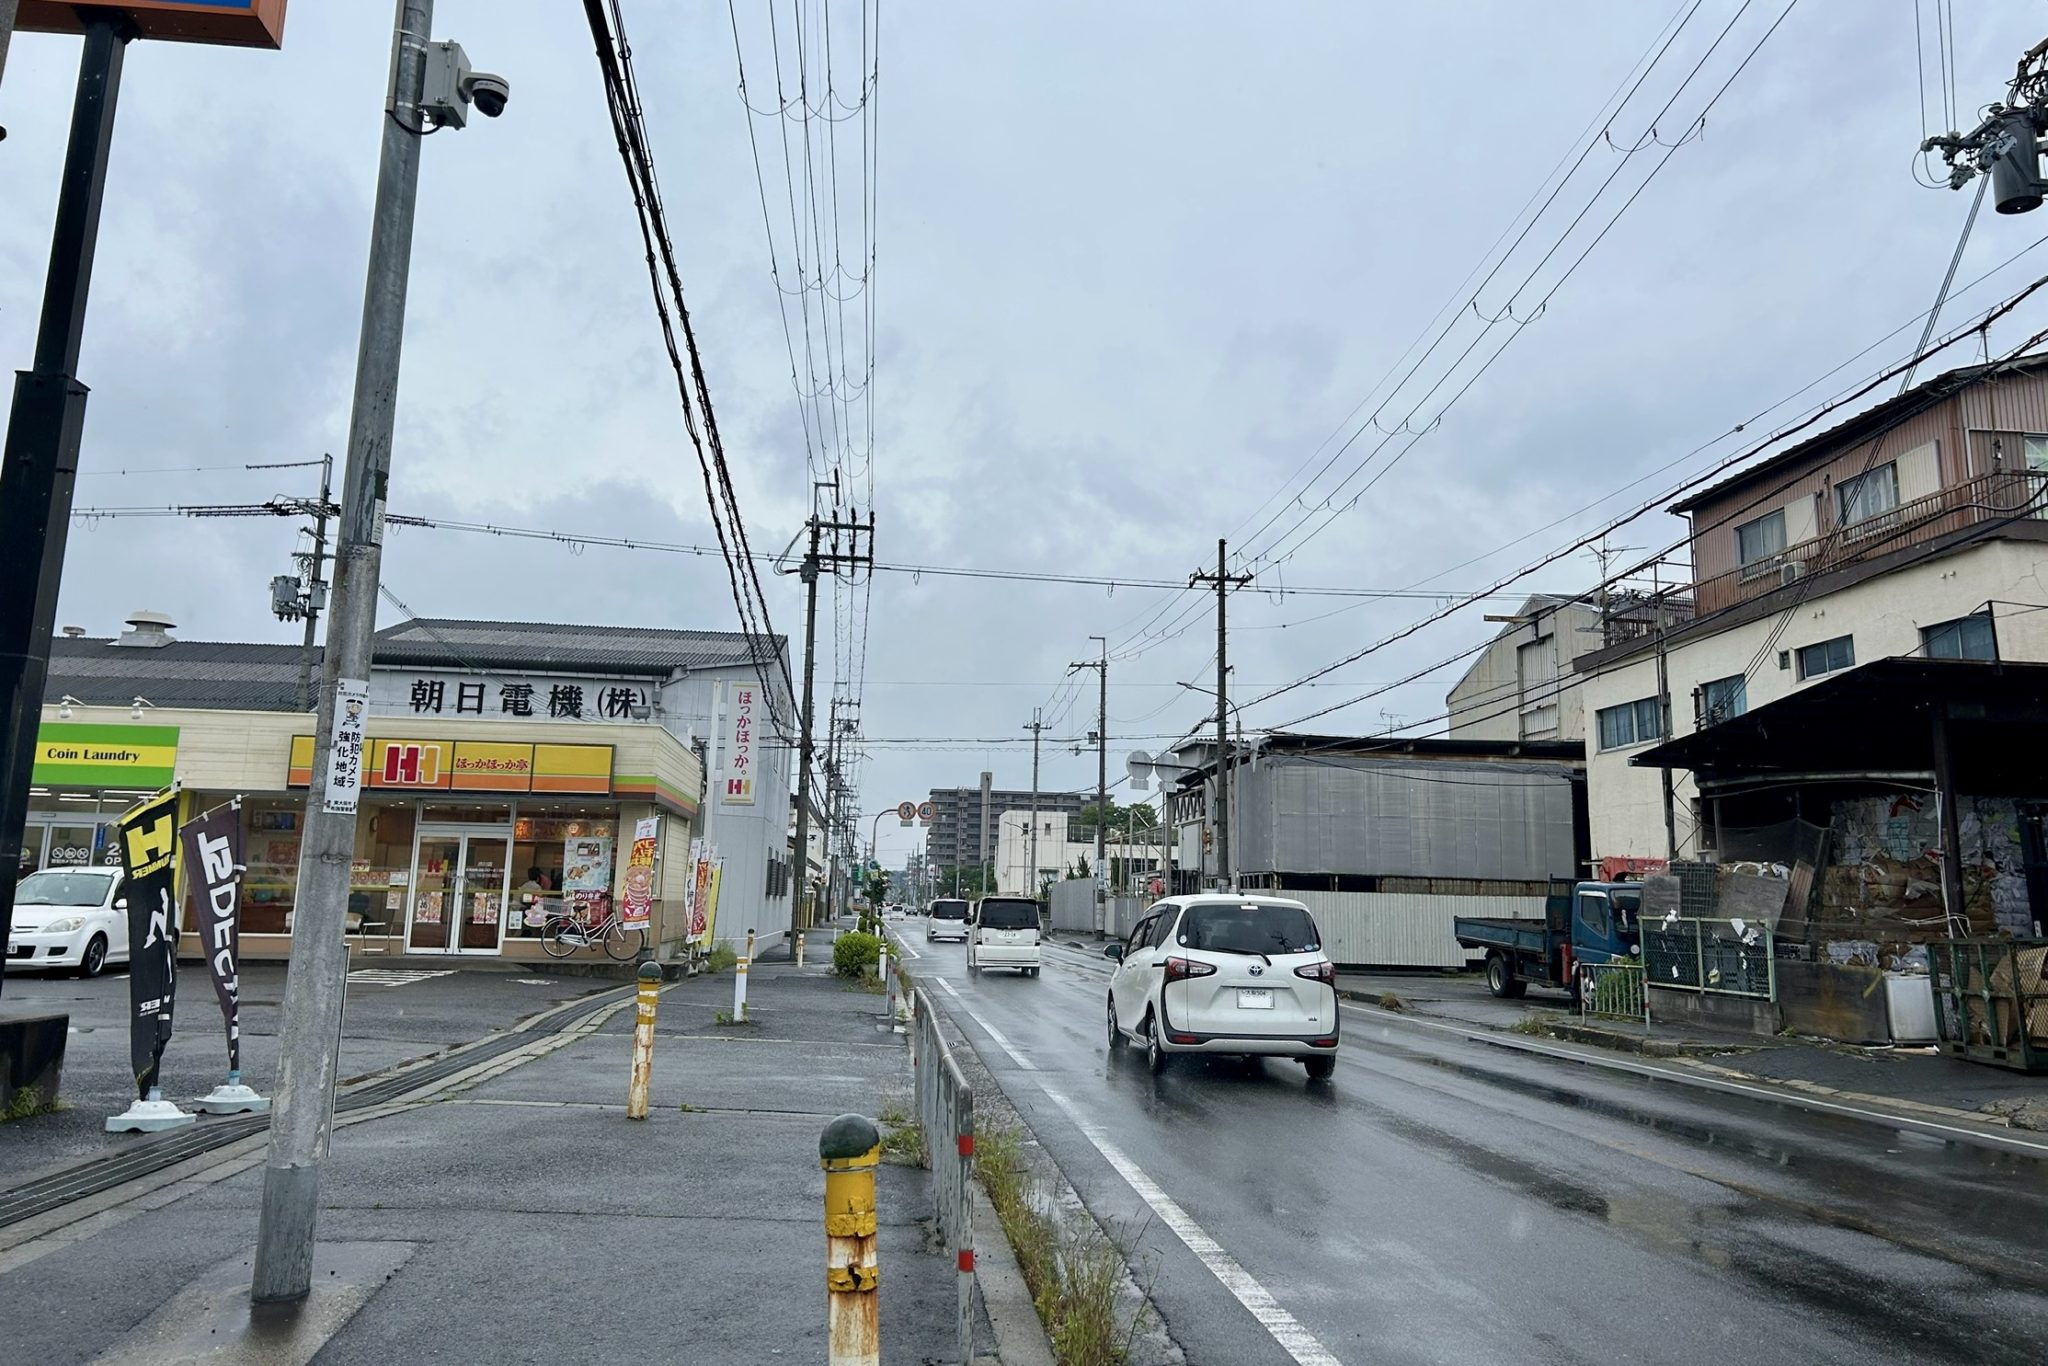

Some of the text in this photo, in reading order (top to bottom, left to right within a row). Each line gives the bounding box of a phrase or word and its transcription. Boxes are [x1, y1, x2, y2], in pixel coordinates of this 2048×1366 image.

[47, 748, 140, 763] Coin Laundry
[333, 731, 351, 788] 強化地域
[346, 732, 361, 788] 防犯カメラ
[455, 757, 528, 771] ほっかほっか亭
[921, 807, 932, 816] 40
